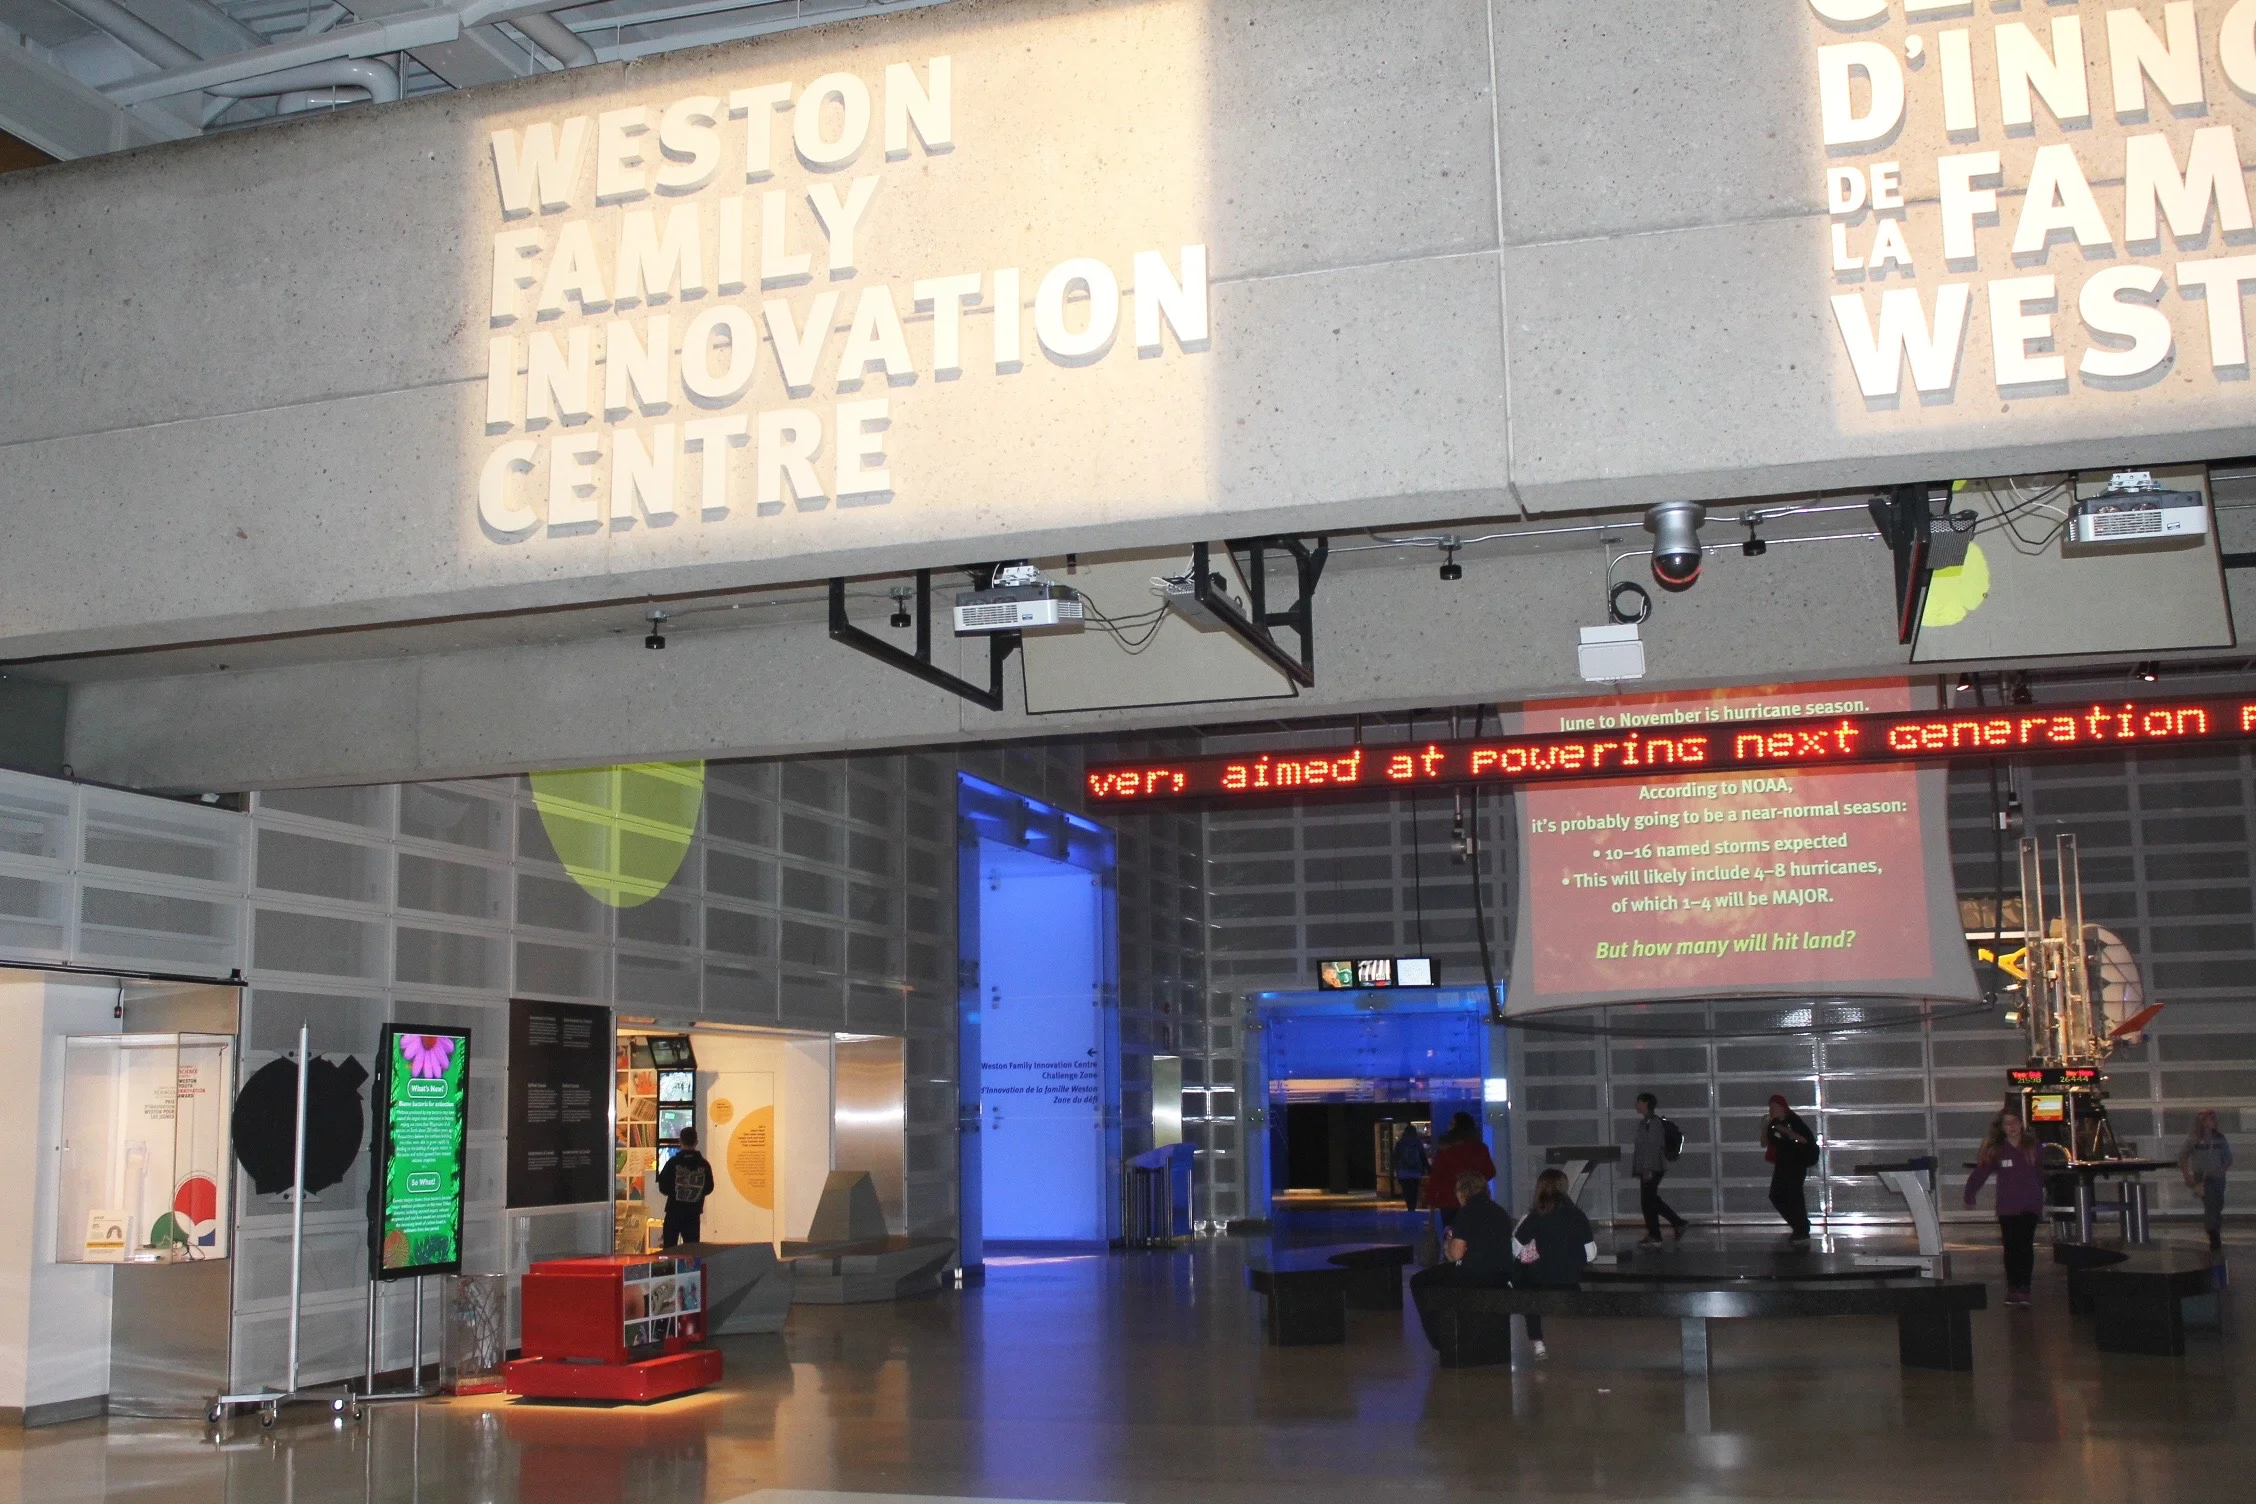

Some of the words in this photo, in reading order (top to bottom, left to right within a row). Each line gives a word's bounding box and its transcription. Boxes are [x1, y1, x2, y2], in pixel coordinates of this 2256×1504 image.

[491, 55, 954, 219] WESTON
[1827, 161, 1904, 214] DE
[1937, 125, 2254, 260] FAM
[491, 176, 881, 324] FAMILY
[1831, 219, 1914, 270] LA
[486, 244, 1209, 430] INNOVATION
[1830, 256, 2256, 396] WEST
[478, 398, 893, 538] CENTRE
[1559, 717, 1595, 733] June
[1599, 714, 1616, 729] to
[1620, 708, 1702, 727] November
[1705, 706, 1720, 722] is
[1724, 702, 1801, 720] hurricane
[1805, 700, 1870, 715] season.
[1222, 749, 1361, 789] aimed
[1388, 745, 1444, 778] at
[1736, 720, 1859, 759] next
[1639, 782, 1717, 800] According
[1721, 782, 1737, 795] to
[1742, 778, 1793, 794] NOAA,
[1532, 819, 1557, 833] it's
[1561, 814, 1630, 835] probably
[1634, 811, 1680, 830] going
[1683, 810, 1699, 824] to
[1704, 808, 1723, 823] be
[1728, 811, 1737, 821] a
[1742, 801, 1840, 821] near-normal
[1844, 800, 1907, 815] season:
[1657, 840, 1710, 857] named
[1715, 840, 1770, 854] storms
[1775, 832, 1848, 852] expected
[1574, 873, 1607, 888] This
[1611, 870, 1640, 886] will
[1644, 868, 1686, 886] likely
[1691, 865, 1749, 882] include
[1790, 860, 1883, 876] hurricanes,
[1612, 897, 1628, 913] of
[1631, 895, 1677, 912] which
[1715, 891, 1744, 908] will
[1748, 891, 1768, 906] be
[1773, 888, 1834, 906] MAJOR.
[1596, 941, 1628, 959] But
[1632, 939, 1672, 957] how
[1676, 938, 1729, 958] many
[1733, 933, 1768, 952] will
[1772, 933, 1799, 950] hit
[1803, 930, 1857, 949] land?
[1010, 1061, 1033, 1071] Family
[1034, 1060, 1073, 1069] Innovation
[1074, 1060, 1098, 1069] Centre
[1042, 1071, 1078, 1080] Challenge
[1080, 1071, 1098, 1079] Zone
[1071, 1085, 1098, 1093] Weston
